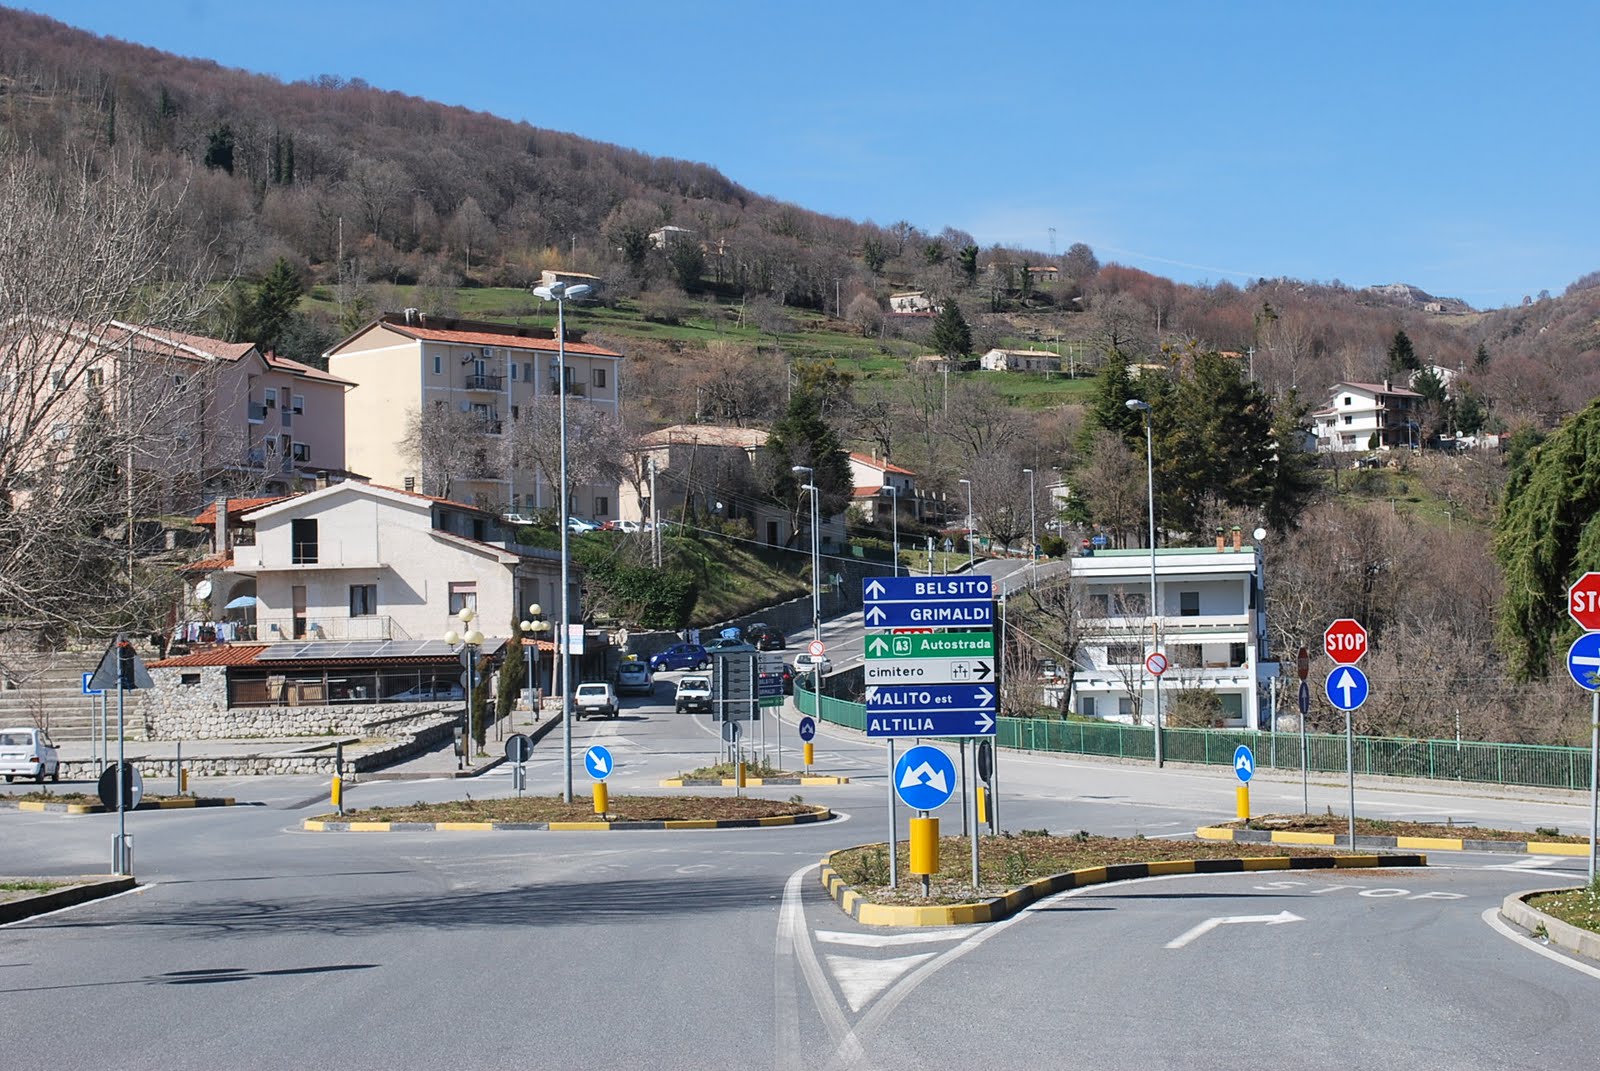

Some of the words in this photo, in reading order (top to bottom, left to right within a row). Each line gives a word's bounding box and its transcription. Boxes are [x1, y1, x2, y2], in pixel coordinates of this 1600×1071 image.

[915, 581, 989, 595] BELSITO
[910, 607, 990, 621] GRIMALDI
[895, 640, 909, 652] A3
[920, 639, 991, 650] Autostrada
[1327, 633, 1366, 651] STOP
[868, 667, 924, 678] cimitero
[868, 692, 931, 705] MALITO
[934, 695, 953, 704] est
[870, 718, 935, 731] ALTILIA
[1254, 881, 1469, 900] STOP
